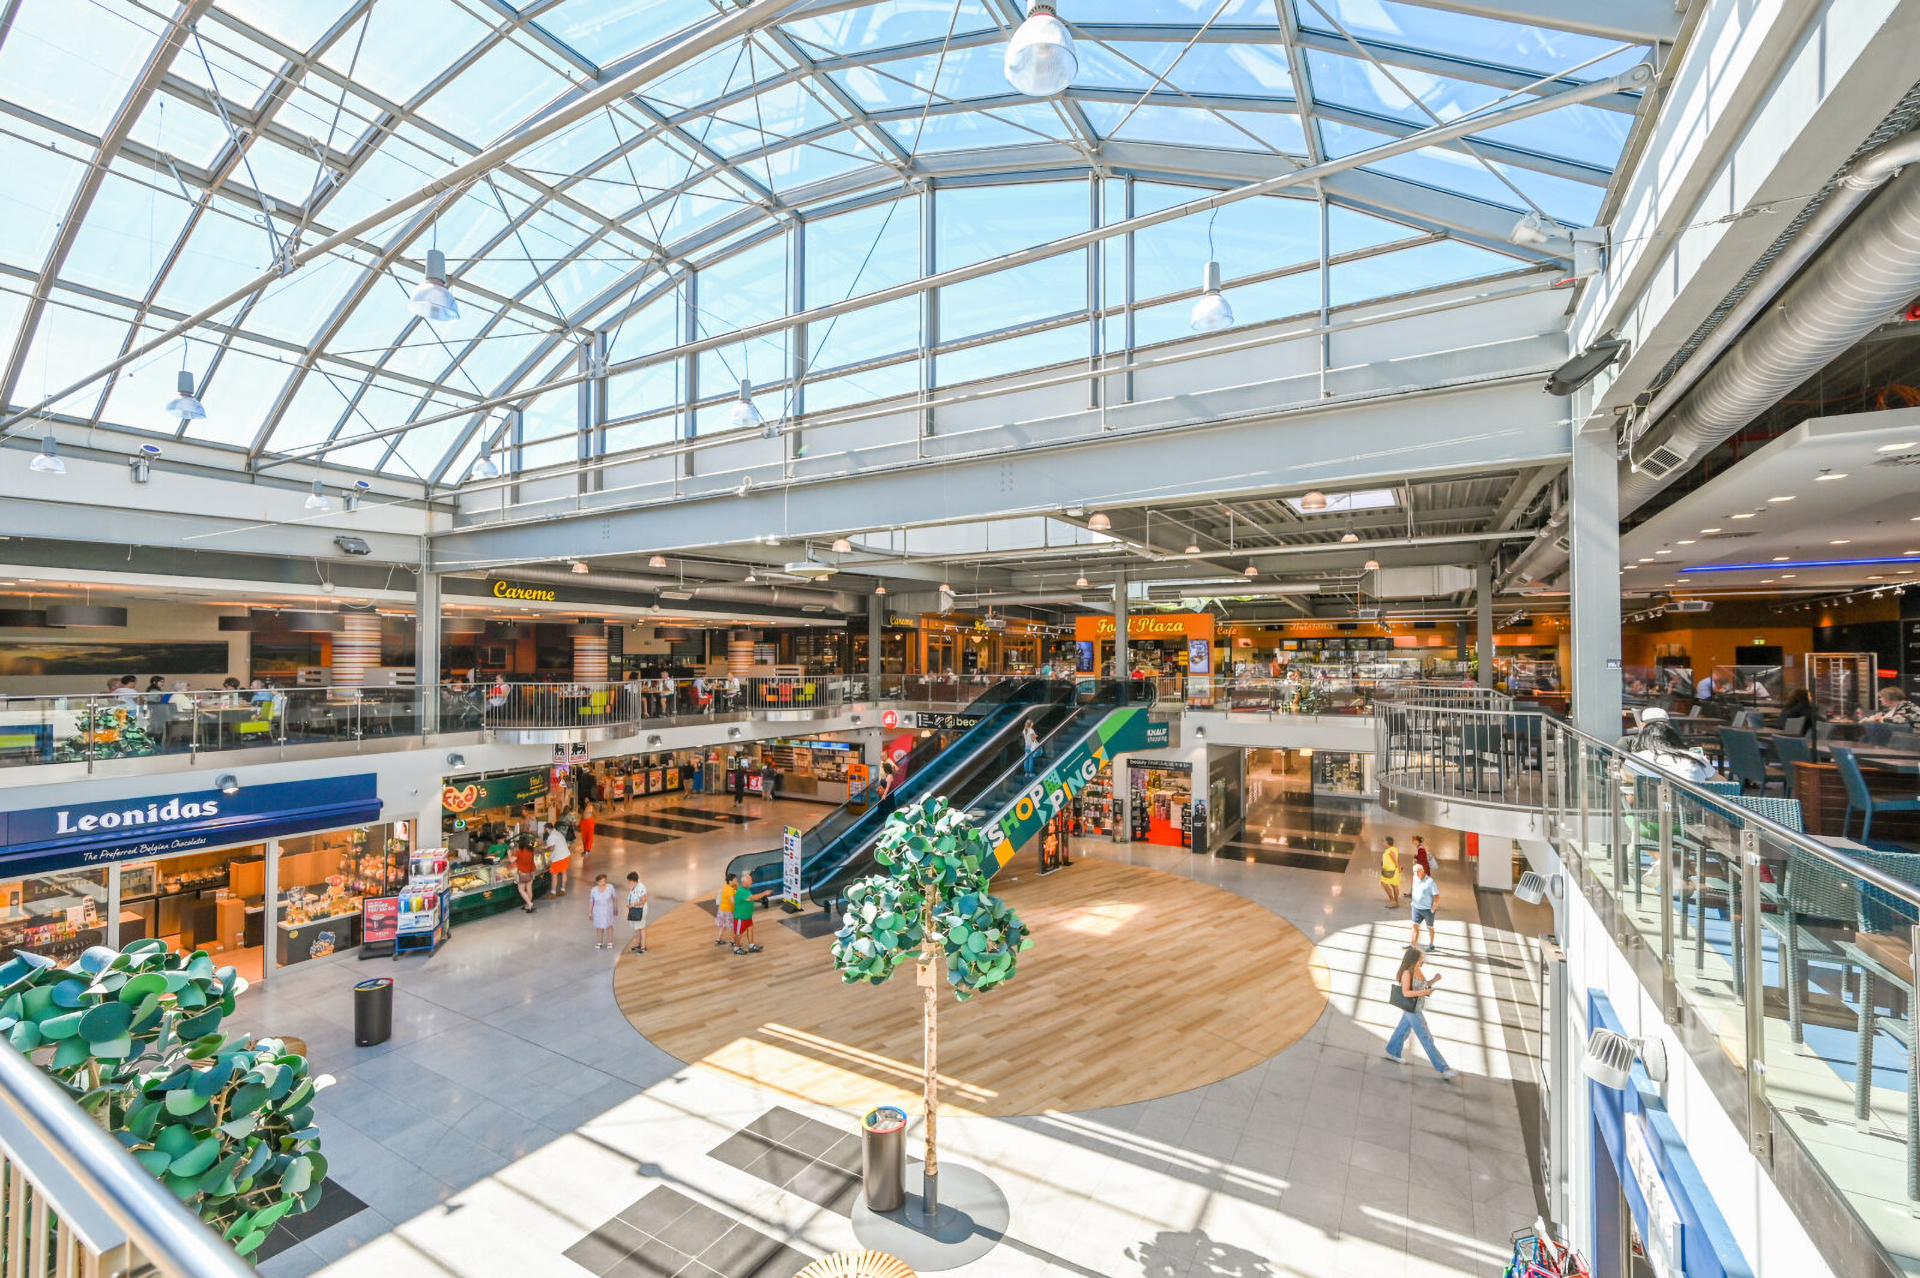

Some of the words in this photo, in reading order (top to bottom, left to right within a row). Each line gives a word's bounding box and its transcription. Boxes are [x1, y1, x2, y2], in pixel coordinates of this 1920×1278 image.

[493, 580, 556, 601] Careme
[1136, 617, 1184, 633] Plaza
[56, 797, 219, 835] Leonidas
[83, 852, 98, 862] The
[99, 848, 138, 861] Preferred
[139, 844, 169, 856] Belgian
[171, 837, 207, 849] Chocolates
